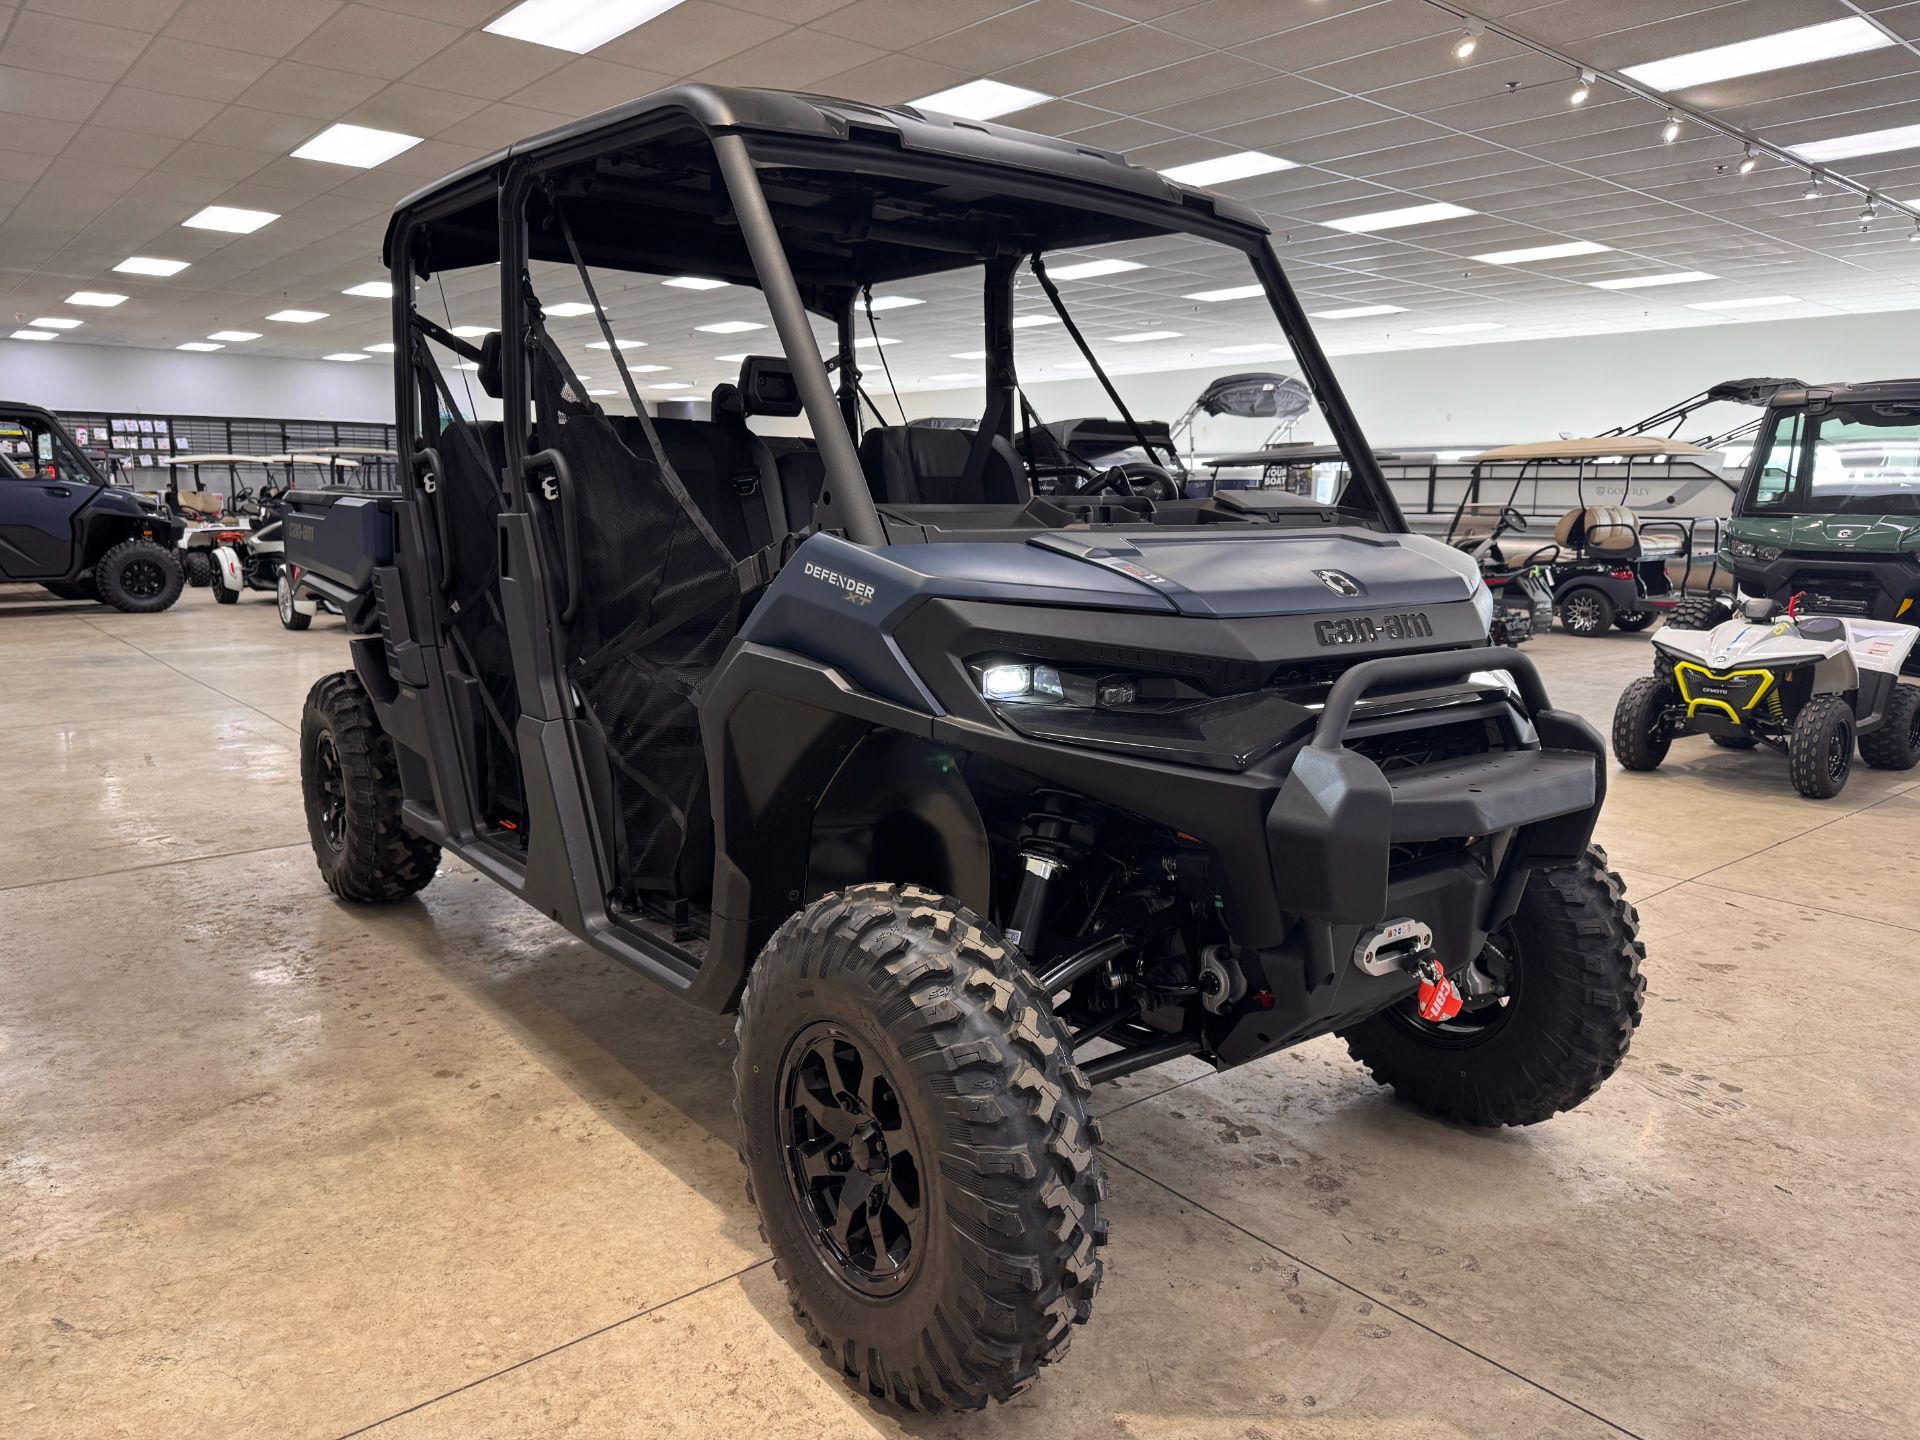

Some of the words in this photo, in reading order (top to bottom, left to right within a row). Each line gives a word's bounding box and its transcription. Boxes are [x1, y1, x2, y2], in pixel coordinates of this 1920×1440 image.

[1266, 468, 1287, 477] YOUR
[1264, 477, 1287, 486] BOAT
[1607, 487, 1651, 496] GOREY
[804, 562, 875, 599] DEFENDER
[846, 592, 873, 606] XT
[1313, 612, 1433, 647] can-am
